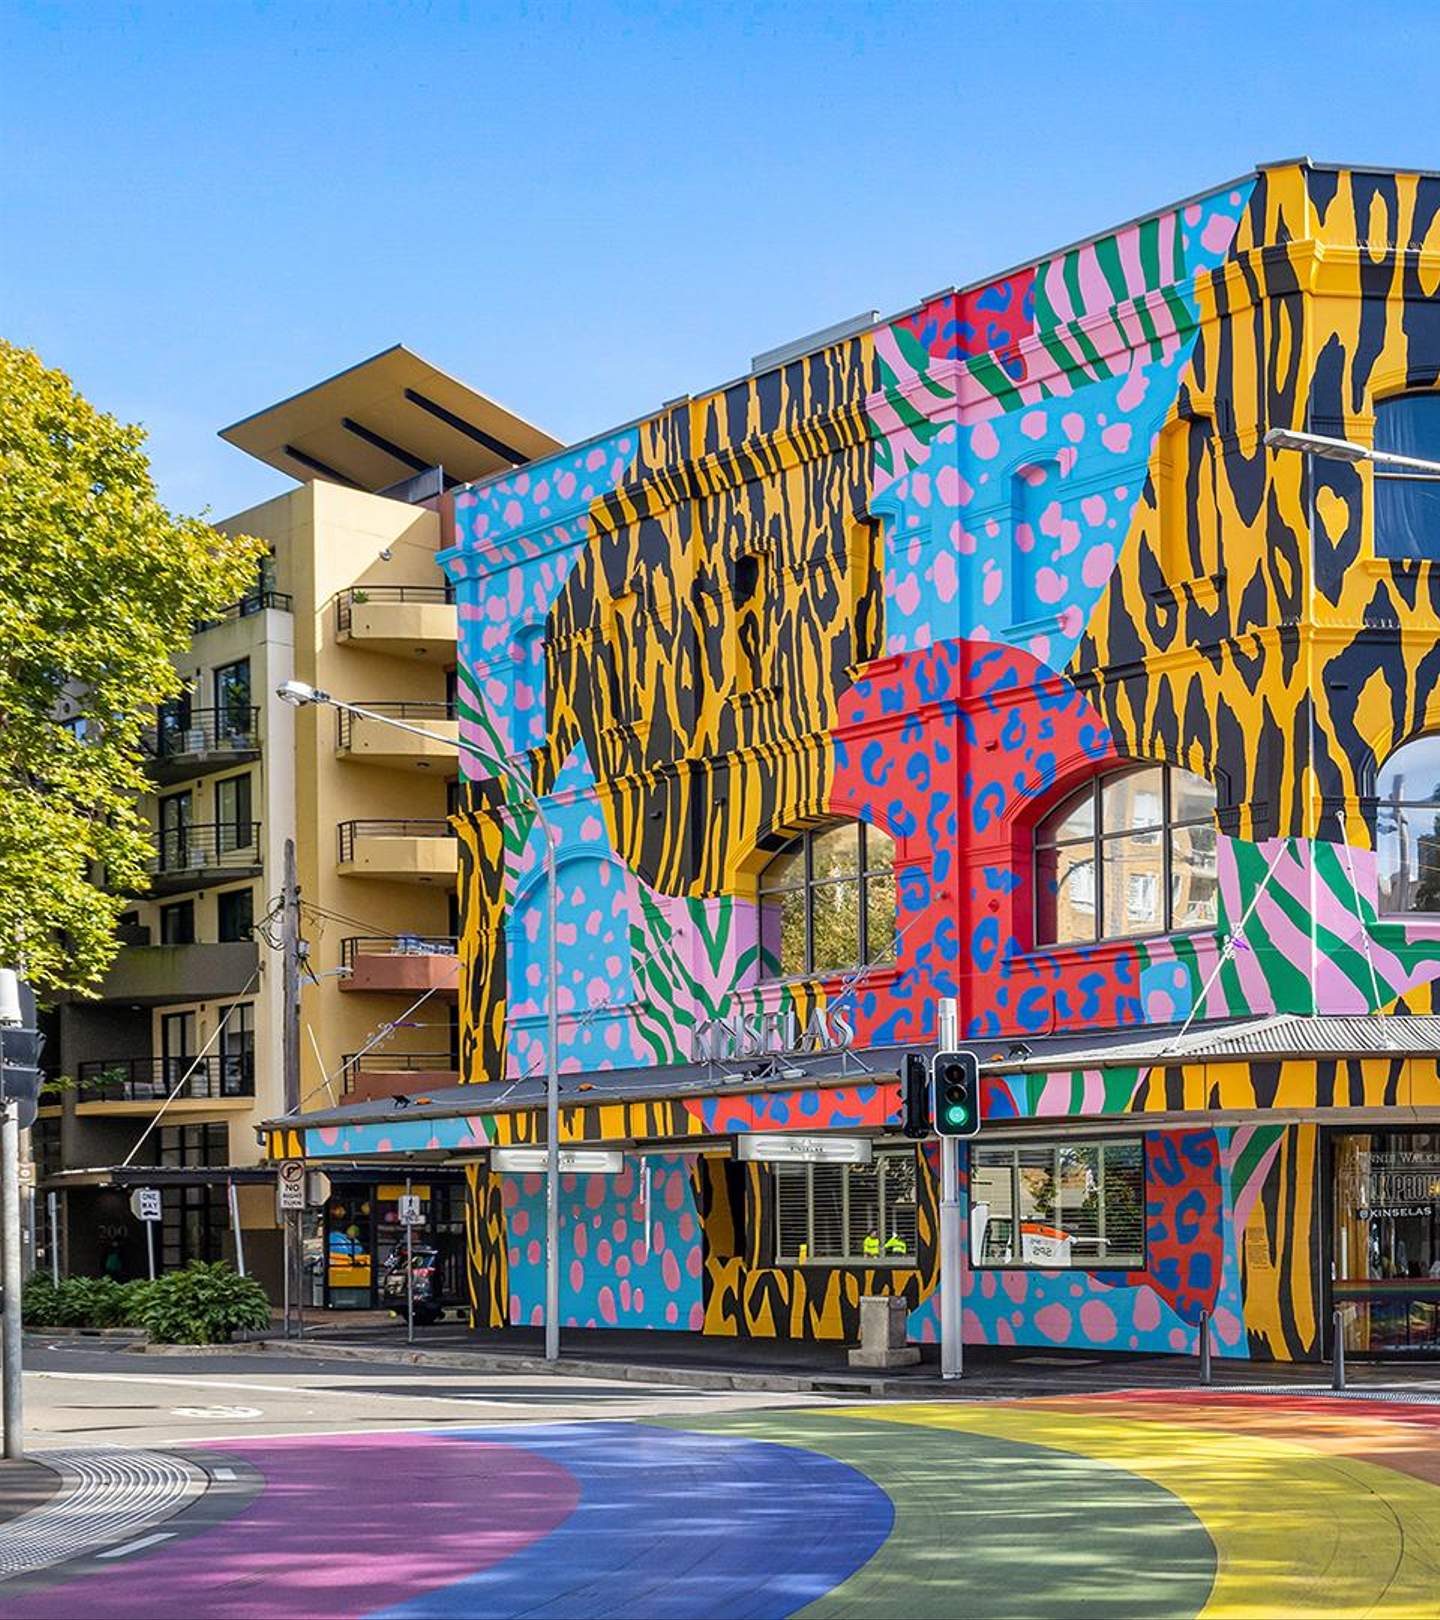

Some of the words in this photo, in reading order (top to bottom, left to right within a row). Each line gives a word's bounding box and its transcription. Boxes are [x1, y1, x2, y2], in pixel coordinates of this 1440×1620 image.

[691, 1005, 855, 1061] KINSELAS
[286, 1183, 300, 1192] NO
[1360, 1206, 1432, 1218] @KINSELAS
[100, 1224, 127, 1239] 200
